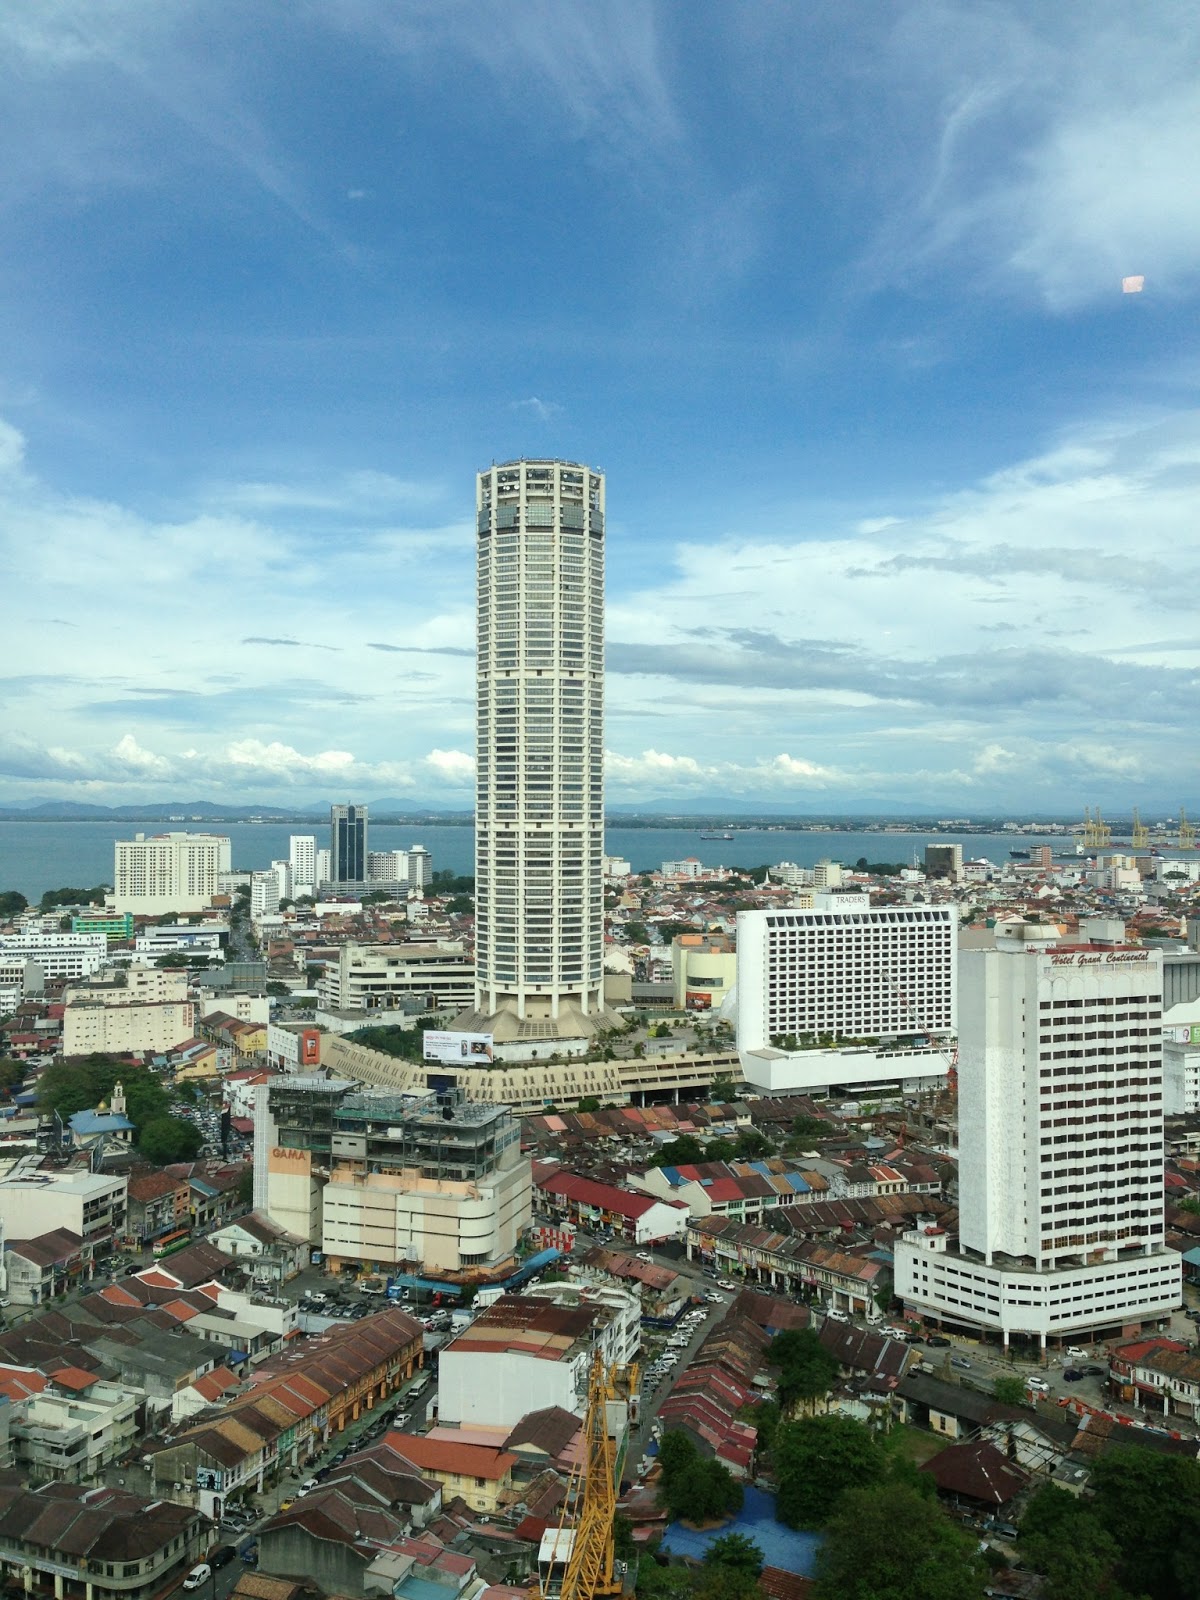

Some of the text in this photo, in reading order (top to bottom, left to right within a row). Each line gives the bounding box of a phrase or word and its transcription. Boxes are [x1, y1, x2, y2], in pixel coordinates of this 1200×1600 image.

[836, 896, 866, 904] TRADERS
[1051, 951, 1149, 968] Hotel Grand Continental
[272, 1148, 306, 1160] GAMA
